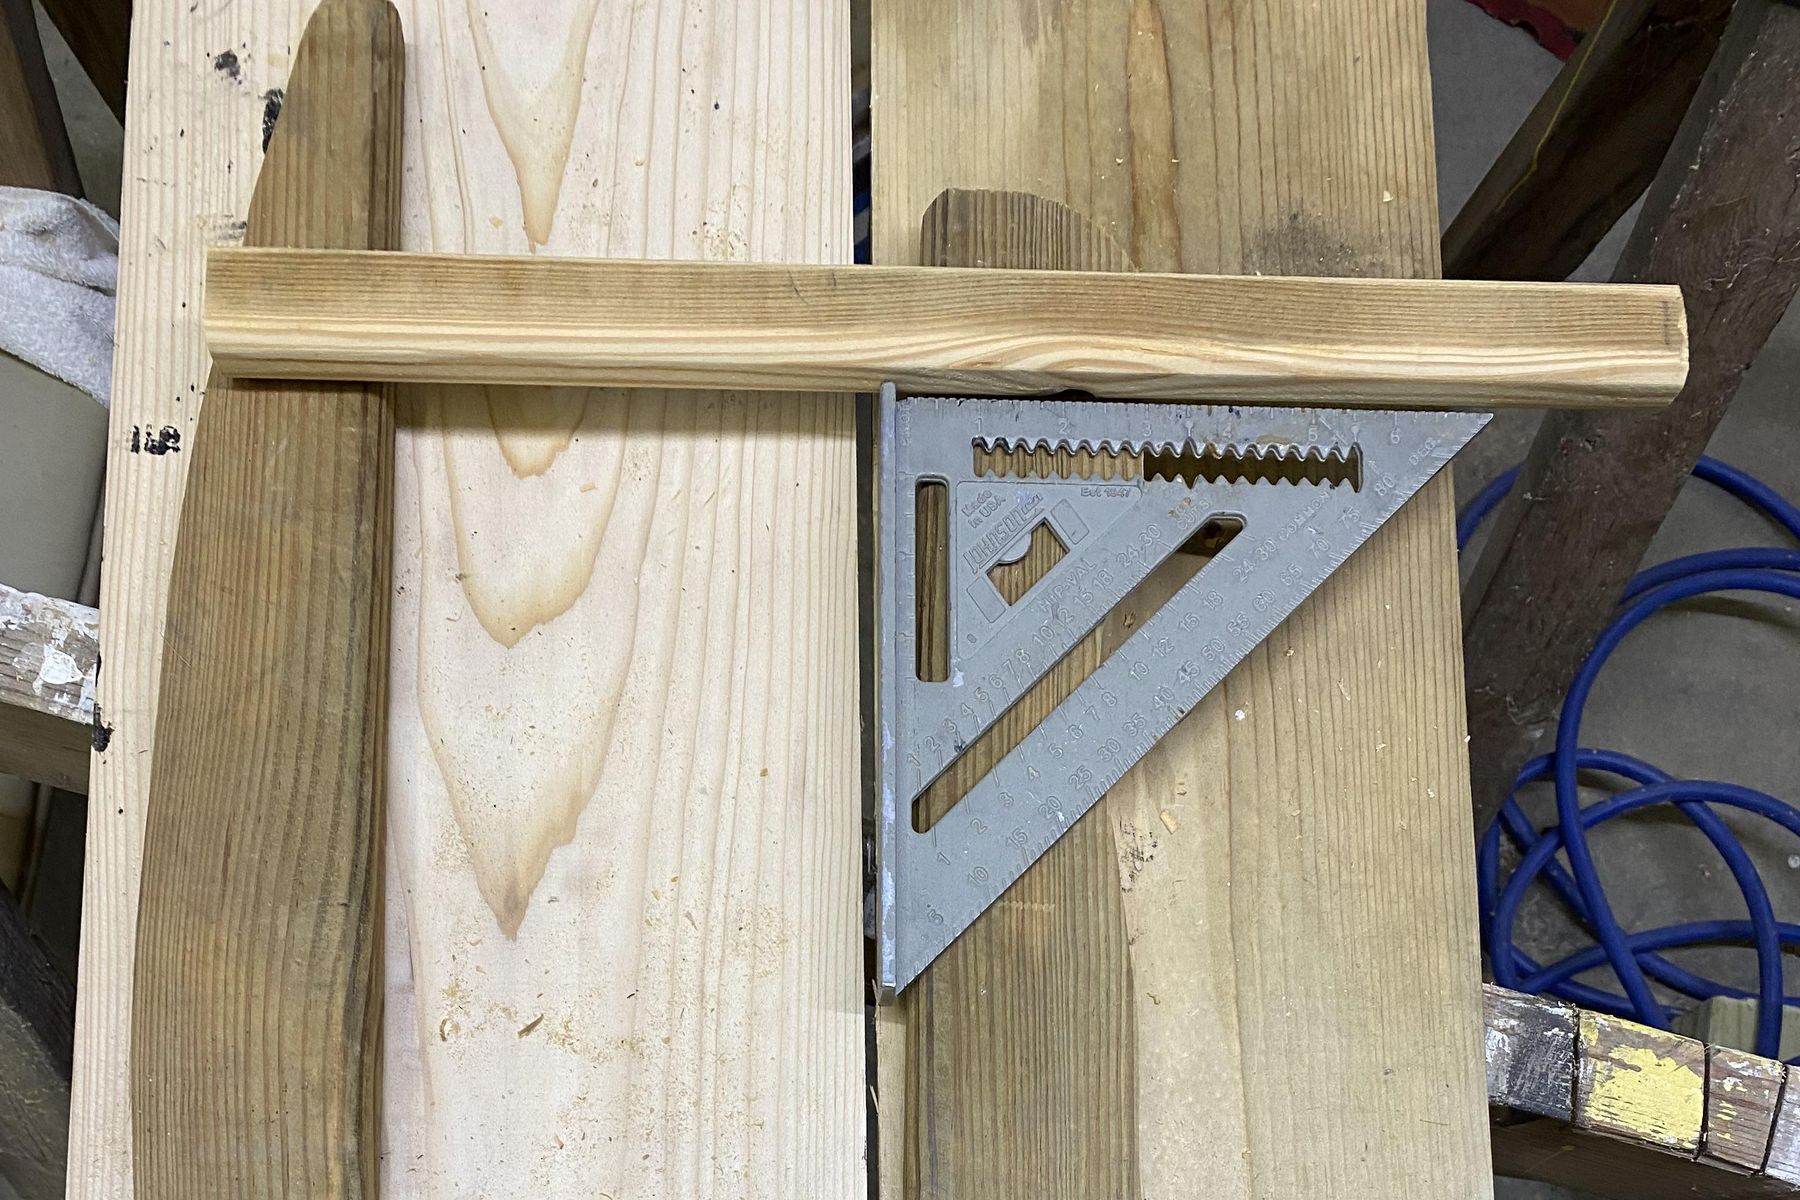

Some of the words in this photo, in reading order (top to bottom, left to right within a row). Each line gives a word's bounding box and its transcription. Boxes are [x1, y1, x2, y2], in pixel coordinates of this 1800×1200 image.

[1058, 420, 1072, 435] 2
[1144, 421, 1153, 436] 3
[1307, 425, 1319, 441] 5
[1390, 427, 1401, 443] 6
[926, 736, 941, 751] 2
[943, 718, 957, 733] 3
[961, 703, 974, 717] 4
[975, 687, 989, 701] 5
[989, 674, 1003, 688] 6
[1003, 659, 1017, 676] 7
[1016, 648, 1030, 664] 8
[1032, 627, 1056, 647] 10
[1056, 606, 1075, 627] 12
[1073, 590, 1095, 610] 15
[1091, 568, 1115, 590] 18
[1138, 523, 1162, 547] 30
[927, 909, 944, 927] 5
[968, 866, 990, 888] 10
[1006, 827, 1029, 850] 15
[1037, 796, 1063, 820] 20
[1068, 764, 1093, 791] 25
[1097, 737, 1122, 762] 30
[1122, 712, 1147, 737] 35
[1151, 686, 1176, 711] 40
[1176, 659, 1201, 685] 45
[1201, 637, 1226, 662] 50
[1226, 612, 1251, 638] 55
[1251, 589, 1276, 613] 60
[1279, 562, 1304, 587] 65
[1307, 535, 1331, 559] 70
[1338, 507, 1362, 531] 75
[1373, 475, 1397, 497] 80
[937, 851, 951, 866] 1
[970, 818, 988, 835] 2
[1000, 791, 1015, 807] 3
[1027, 765, 1041, 780] 4
[1048, 743, 1064, 759] 5
[1067, 724, 1083, 739] 6
[1083, 704, 1100, 721] 7
[1102, 691, 1118, 707] 8
[1128, 660, 1151, 682] 10
[1152, 637, 1176, 658] 12
[1178, 612, 1201, 633] 15
[1202, 589, 1224, 611] 18
[1254, 537, 1279, 562] 30
